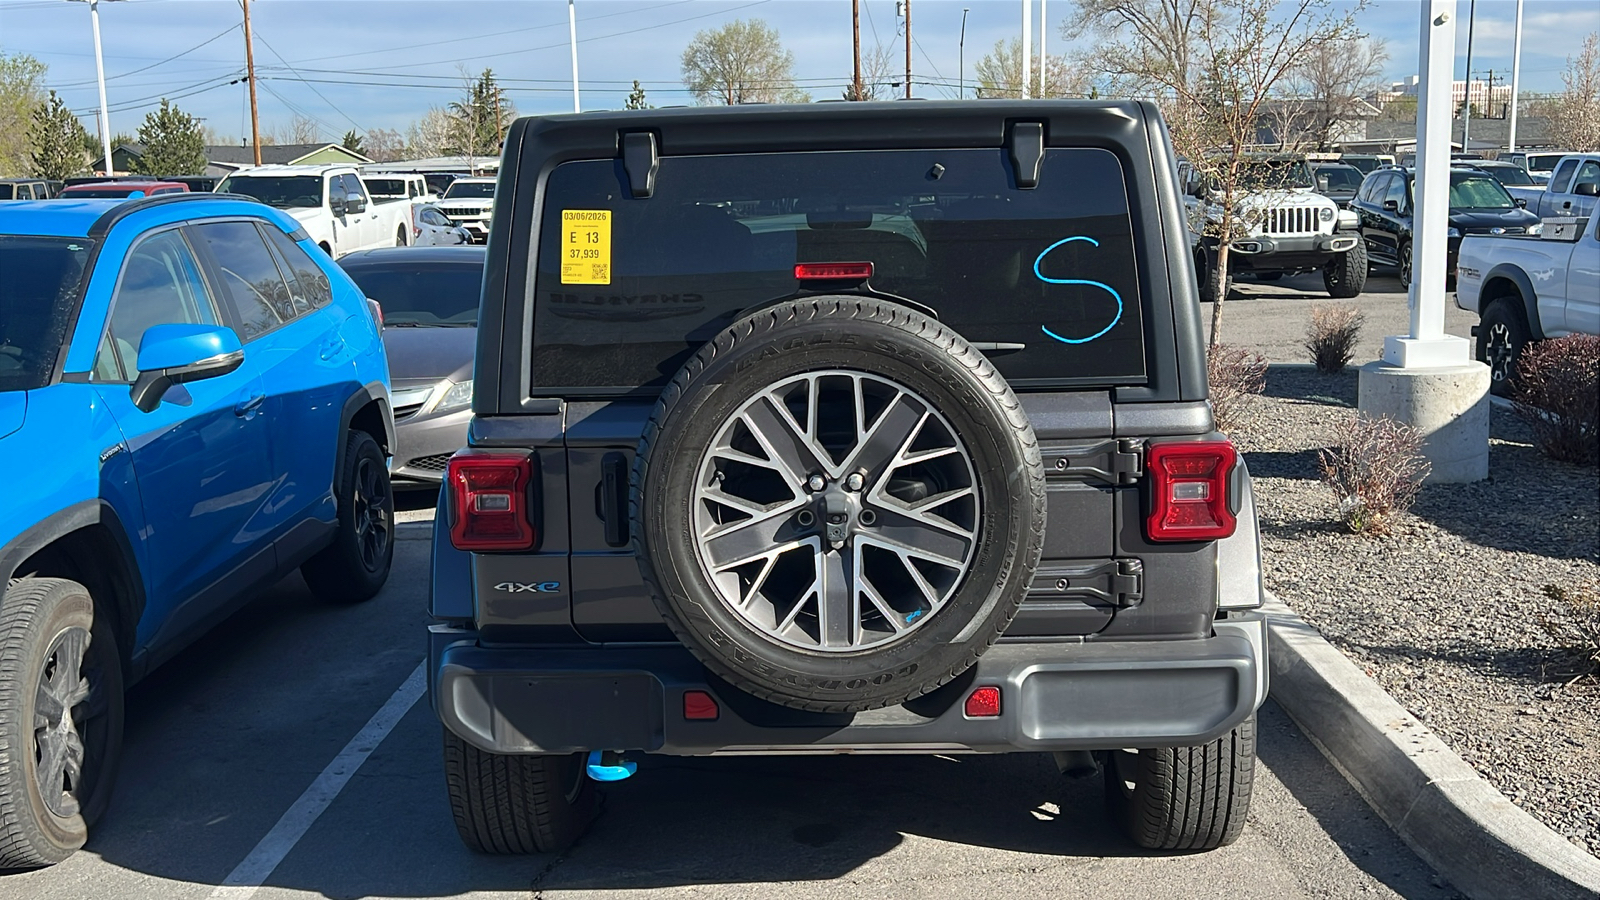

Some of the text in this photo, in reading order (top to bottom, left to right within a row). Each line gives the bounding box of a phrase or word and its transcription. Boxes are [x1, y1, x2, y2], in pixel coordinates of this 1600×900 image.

[564, 212, 607, 221] 03/06/2026
[569, 249, 600, 260] 37,939
[570, 231, 599, 244] E 13
[1034, 236, 1123, 344] S
[734, 332, 860, 374] EAGLE
[874, 339, 984, 409] SPORT
[708, 630, 919, 692] GOODYEAR
